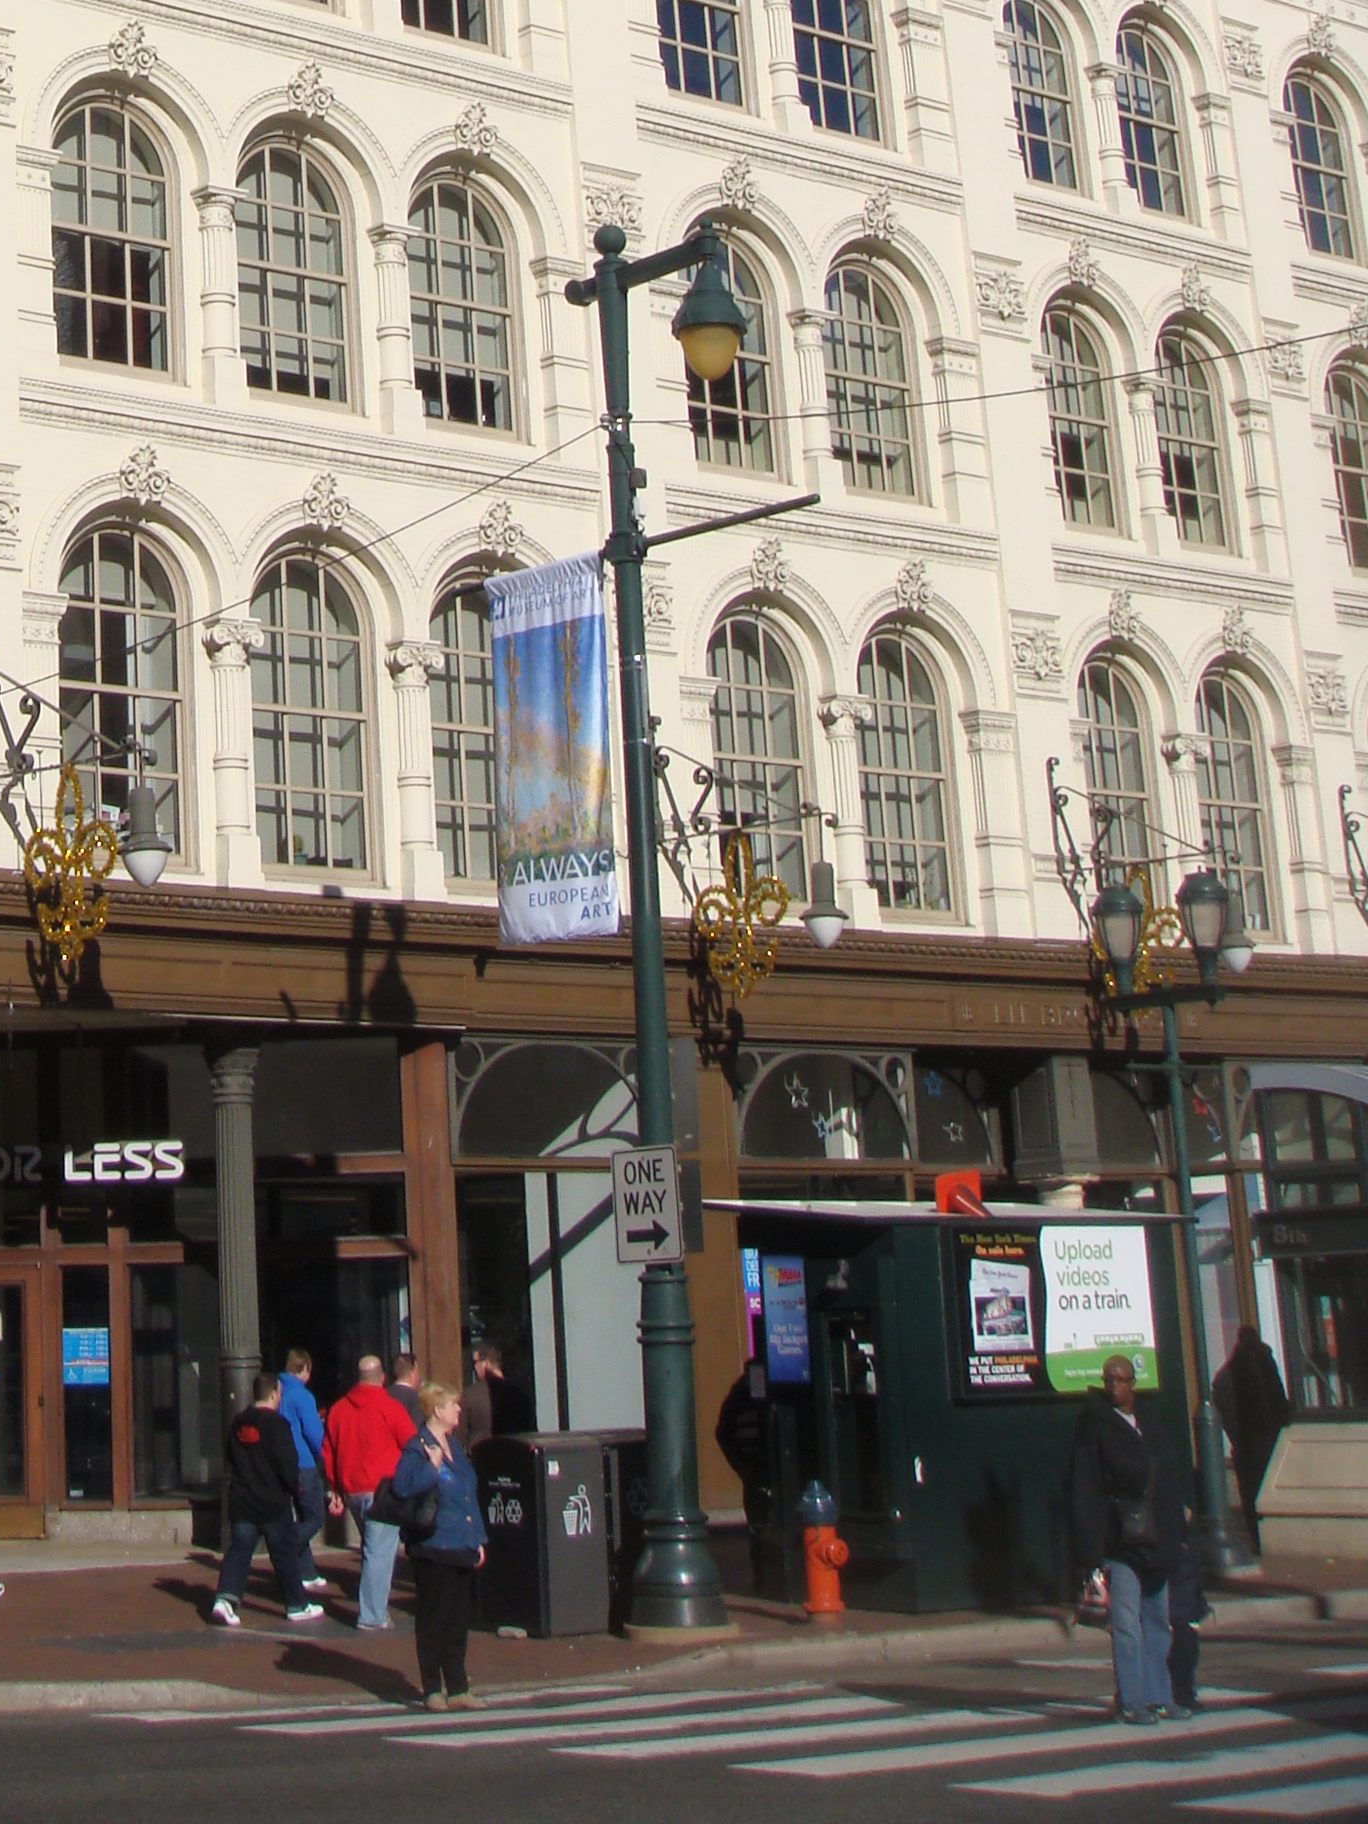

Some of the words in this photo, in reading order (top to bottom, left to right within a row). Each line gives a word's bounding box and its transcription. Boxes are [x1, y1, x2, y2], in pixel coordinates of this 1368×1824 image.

[509, 598, 553, 616] MUSEUM
[571, 587, 594, 601] ART
[513, 849, 611, 887] ALWAYS
[528, 884, 610, 908] EUROPEAN
[580, 901, 612, 920] ART
[64, 1141, 184, 1182] LESS
[624, 1158, 665, 1185] ONE
[624, 1189, 666, 1216] WAY
[1054, 1239, 1113, 1264] Upload
[1056, 1266, 1110, 1287] videos
[1059, 1294, 1079, 1310] on
[1082, 1295, 1091, 1310] a
[1094, 1288, 1132, 1311] train.
